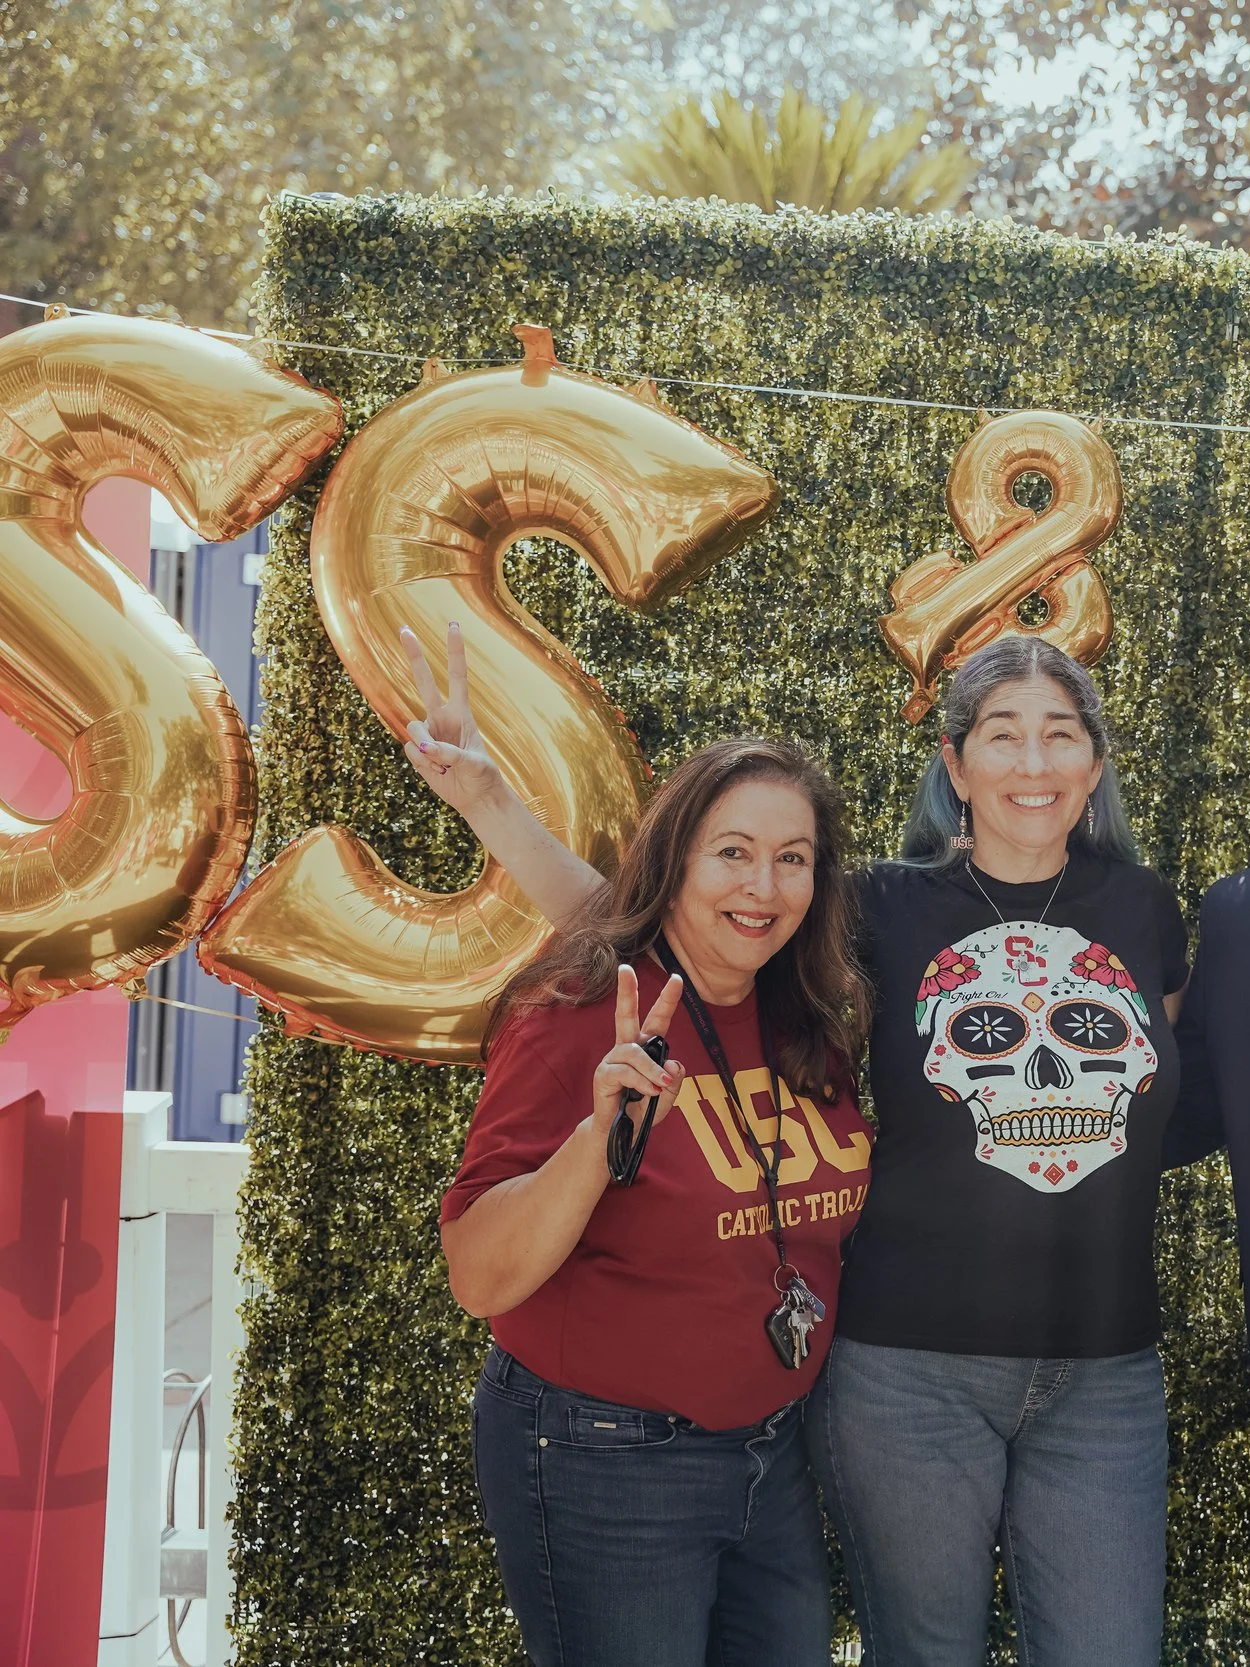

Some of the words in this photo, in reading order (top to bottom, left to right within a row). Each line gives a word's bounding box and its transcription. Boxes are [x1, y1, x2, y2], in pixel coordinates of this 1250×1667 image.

[950, 836, 974, 849] USC
[949, 990, 983, 1004] Fight
[985, 990, 1009, 999] On!
[717, 1198, 801, 1240] CATOLIC
